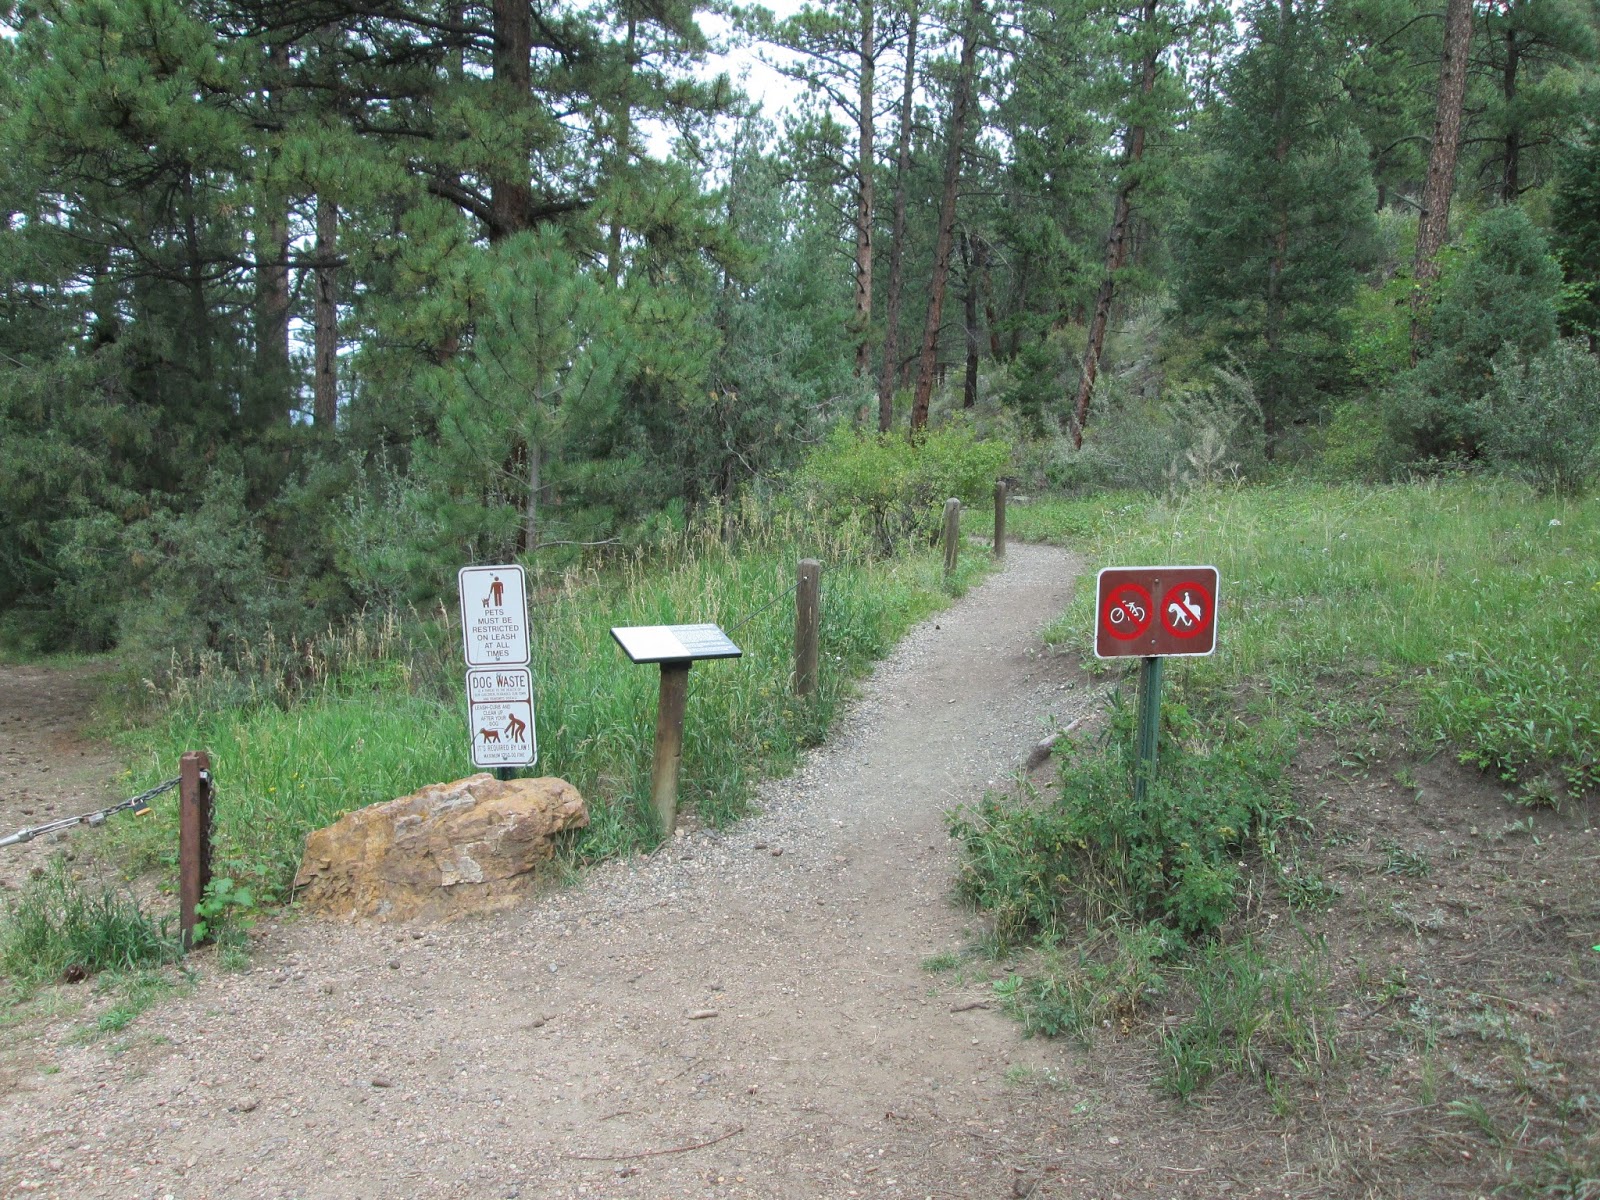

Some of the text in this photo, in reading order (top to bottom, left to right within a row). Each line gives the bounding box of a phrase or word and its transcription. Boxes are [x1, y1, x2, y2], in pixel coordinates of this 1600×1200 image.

[478, 617, 499, 625] MUST
[472, 625, 519, 633] RESTRICTED
[491, 633, 516, 641] LEASH
[473, 675, 525, 689] DOG WASTE
